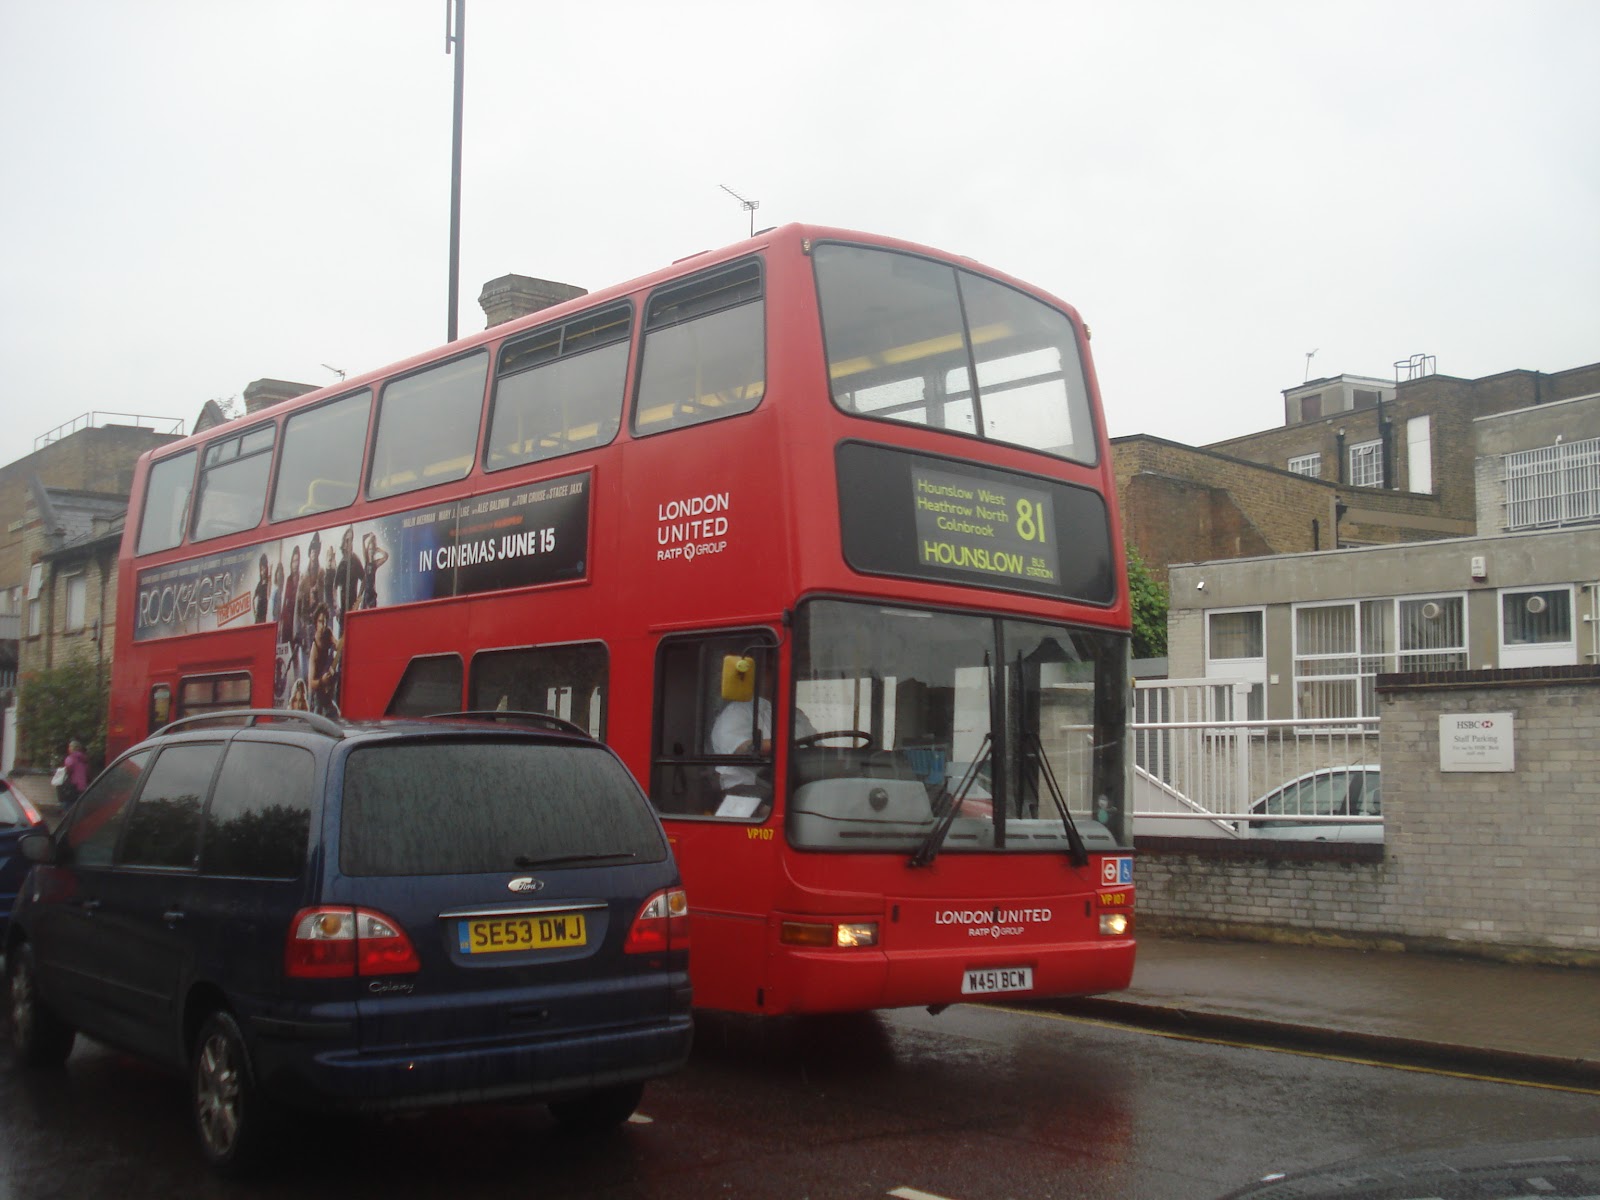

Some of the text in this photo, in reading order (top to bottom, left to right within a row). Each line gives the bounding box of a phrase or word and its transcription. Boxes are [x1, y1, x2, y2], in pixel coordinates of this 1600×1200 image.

[478, 502, 489, 513] ALEC
[517, 493, 528, 505] TOM
[528, 489, 546, 504] CRUISE
[569, 482, 583, 495] JAXX
[917, 479, 1006, 506] Hounslow West
[658, 492, 729, 521] LONDON
[917, 496, 1008, 522] Heathrow North
[658, 516, 728, 545] UNITED
[936, 516, 995, 537] Colnbrook
[1016, 498, 1045, 543] 81
[419, 527, 556, 573] IN CINEMAS JUNE 15
[657, 541, 727, 561] RATP GROUP
[923, 540, 1024, 575] HOUNSLOW
[1026, 567, 1054, 579] STATION
[1031, 557, 1046, 568] BUS
[137, 584, 184, 628] ROCK
[184, 571, 232, 620] AGES
[228, 596, 250, 617] MOVIE
[1456, 721, 1480, 729] HSBC
[1454, 735, 1499, 744] Staff Parking
[746, 827, 774, 841] VP107
[519, 881, 536, 891] Ford
[1100, 893, 1126, 906] VP107
[935, 909, 1052, 924] LONDON UNITED
[473, 917, 582, 947] SE53 DWJ
[968, 926, 1025, 937] RATP GROUP
[969, 970, 1026, 991] W451 BCW
